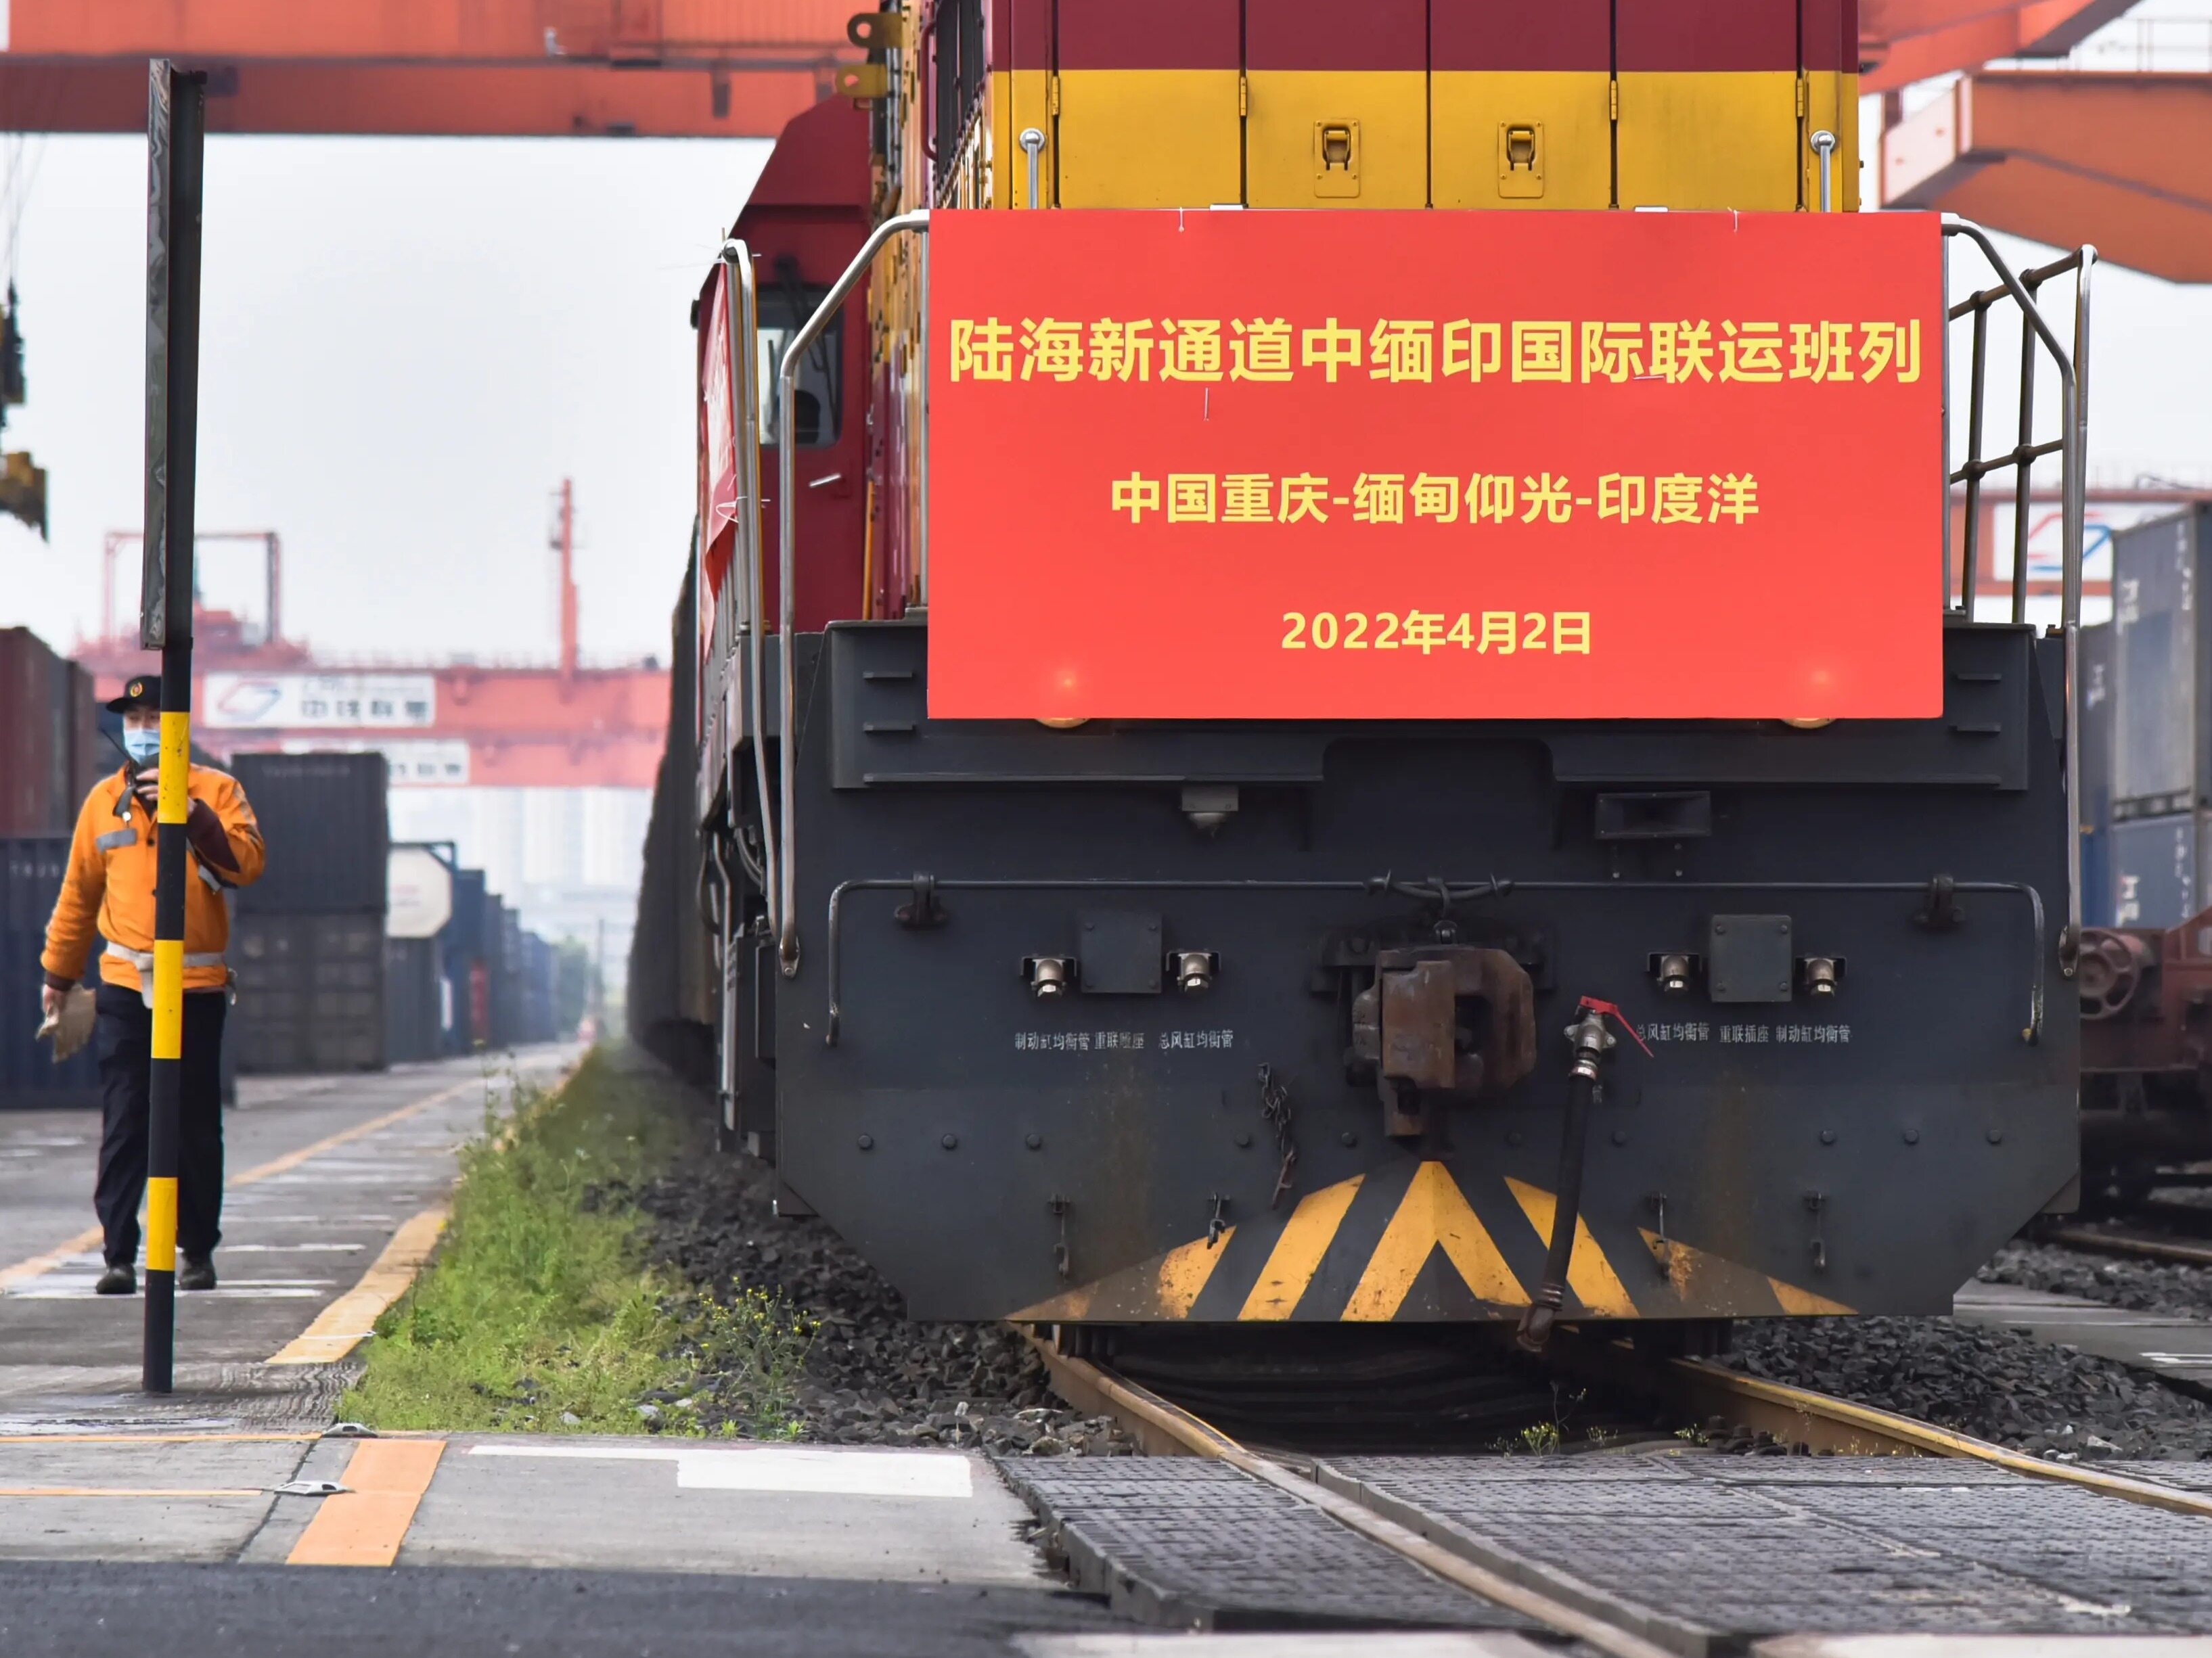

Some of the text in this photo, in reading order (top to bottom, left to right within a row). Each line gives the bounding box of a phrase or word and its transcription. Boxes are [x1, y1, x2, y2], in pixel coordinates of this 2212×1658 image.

[949, 316, 1922, 385] 陆海新通道中缅印国际联运班列
[1111, 471, 1760, 525] 中国重庆-缅甸仰光-印度洋
[1281, 609, 1592, 655] 2022年4月2日
[1719, 1024, 1769, 1043] 重联插座
